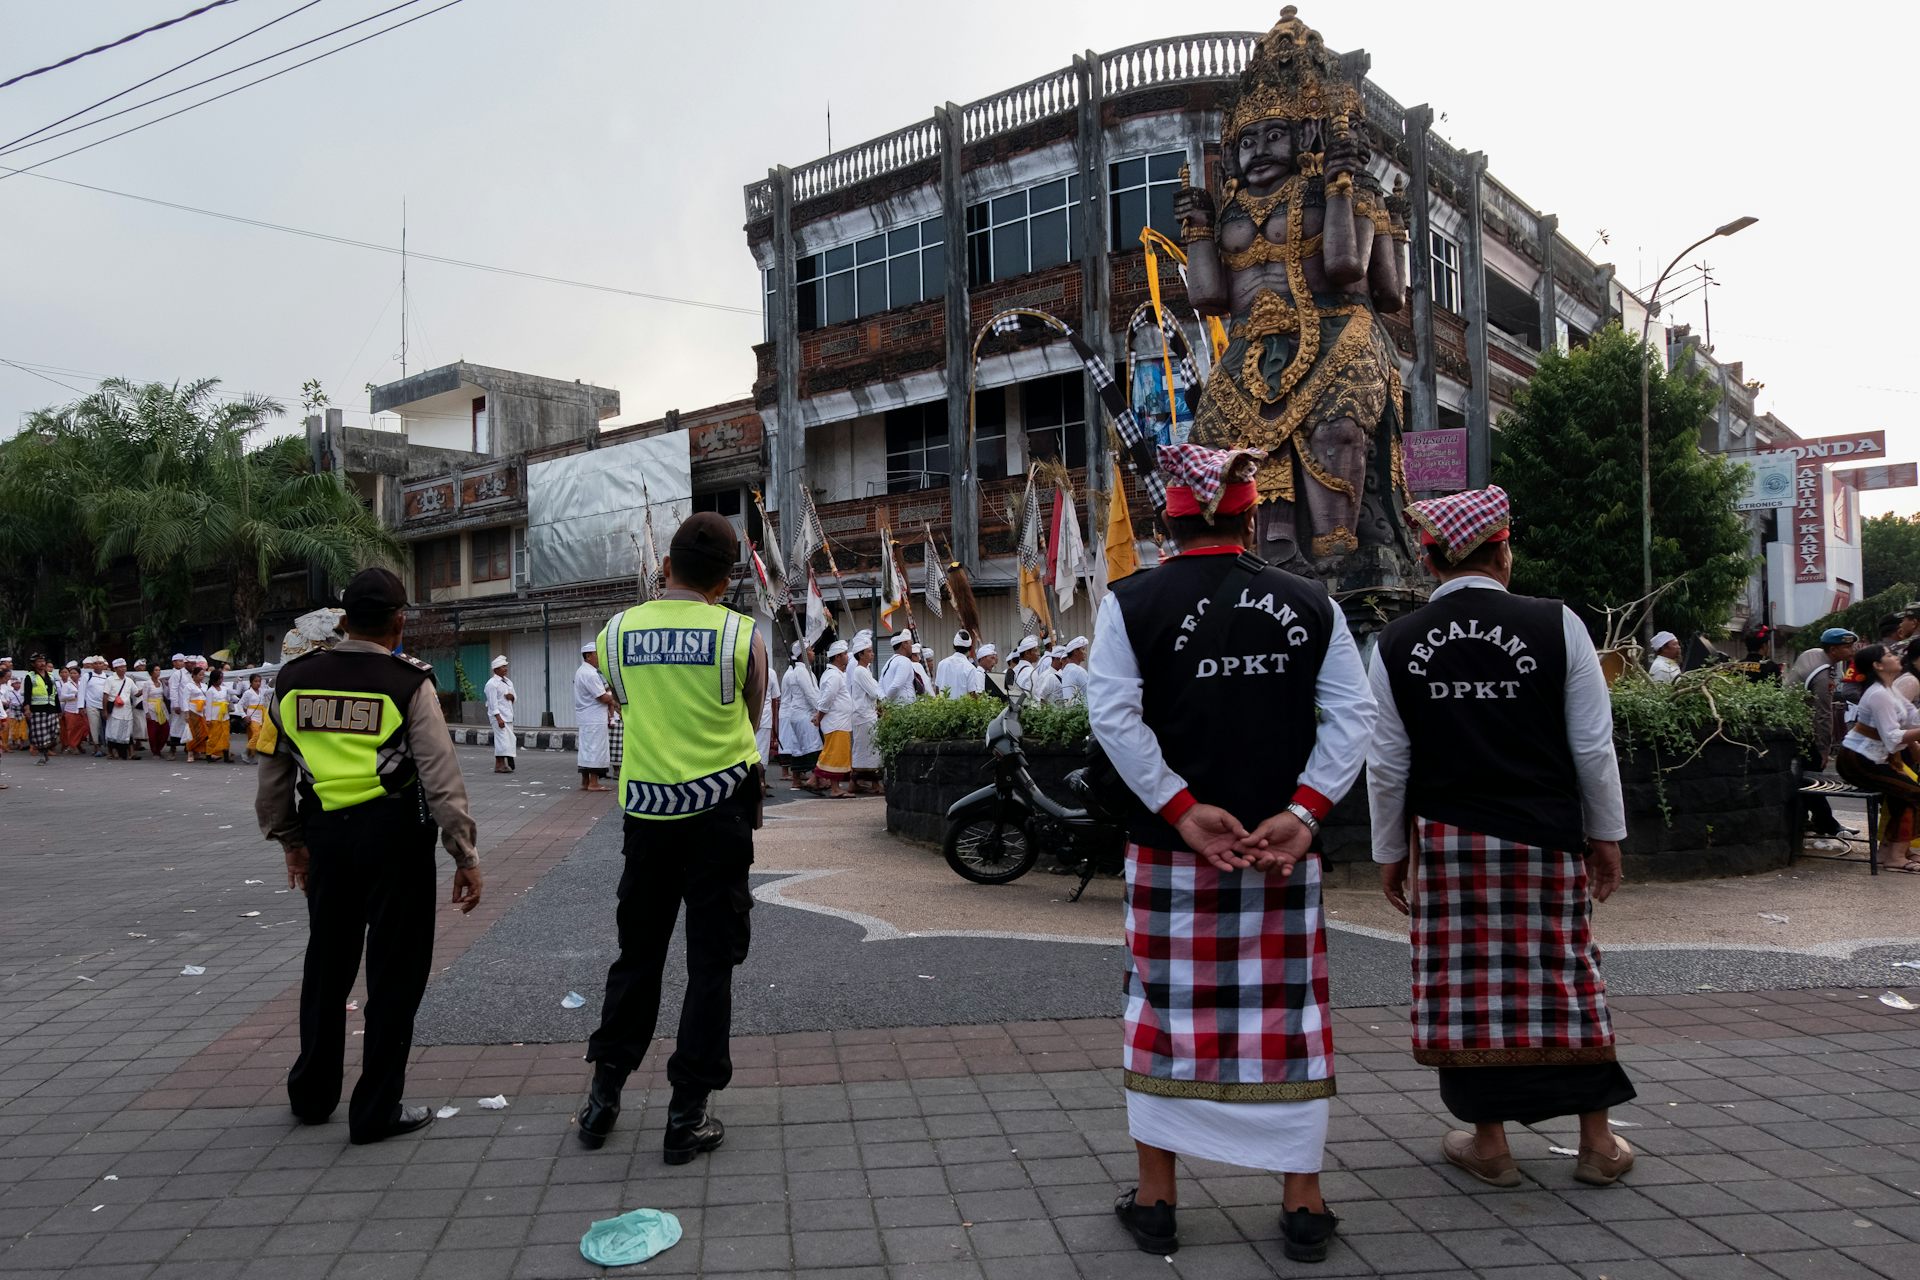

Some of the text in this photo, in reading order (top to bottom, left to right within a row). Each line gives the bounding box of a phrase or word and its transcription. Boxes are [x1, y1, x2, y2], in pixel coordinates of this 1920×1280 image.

[1413, 434, 1459, 446] Busana
[1758, 438, 1882, 460] ONDA
[1797, 467, 1820, 575] ARTHA KARYA
[627, 631, 711, 655] POLISI
[1408, 619, 1538, 677] PECALANG
[627, 654, 710, 663] POLRES TABANAN
[1195, 653, 1290, 678] DPKT
[1428, 681, 1521, 699] DPKT
[298, 698, 380, 732] POLISI
